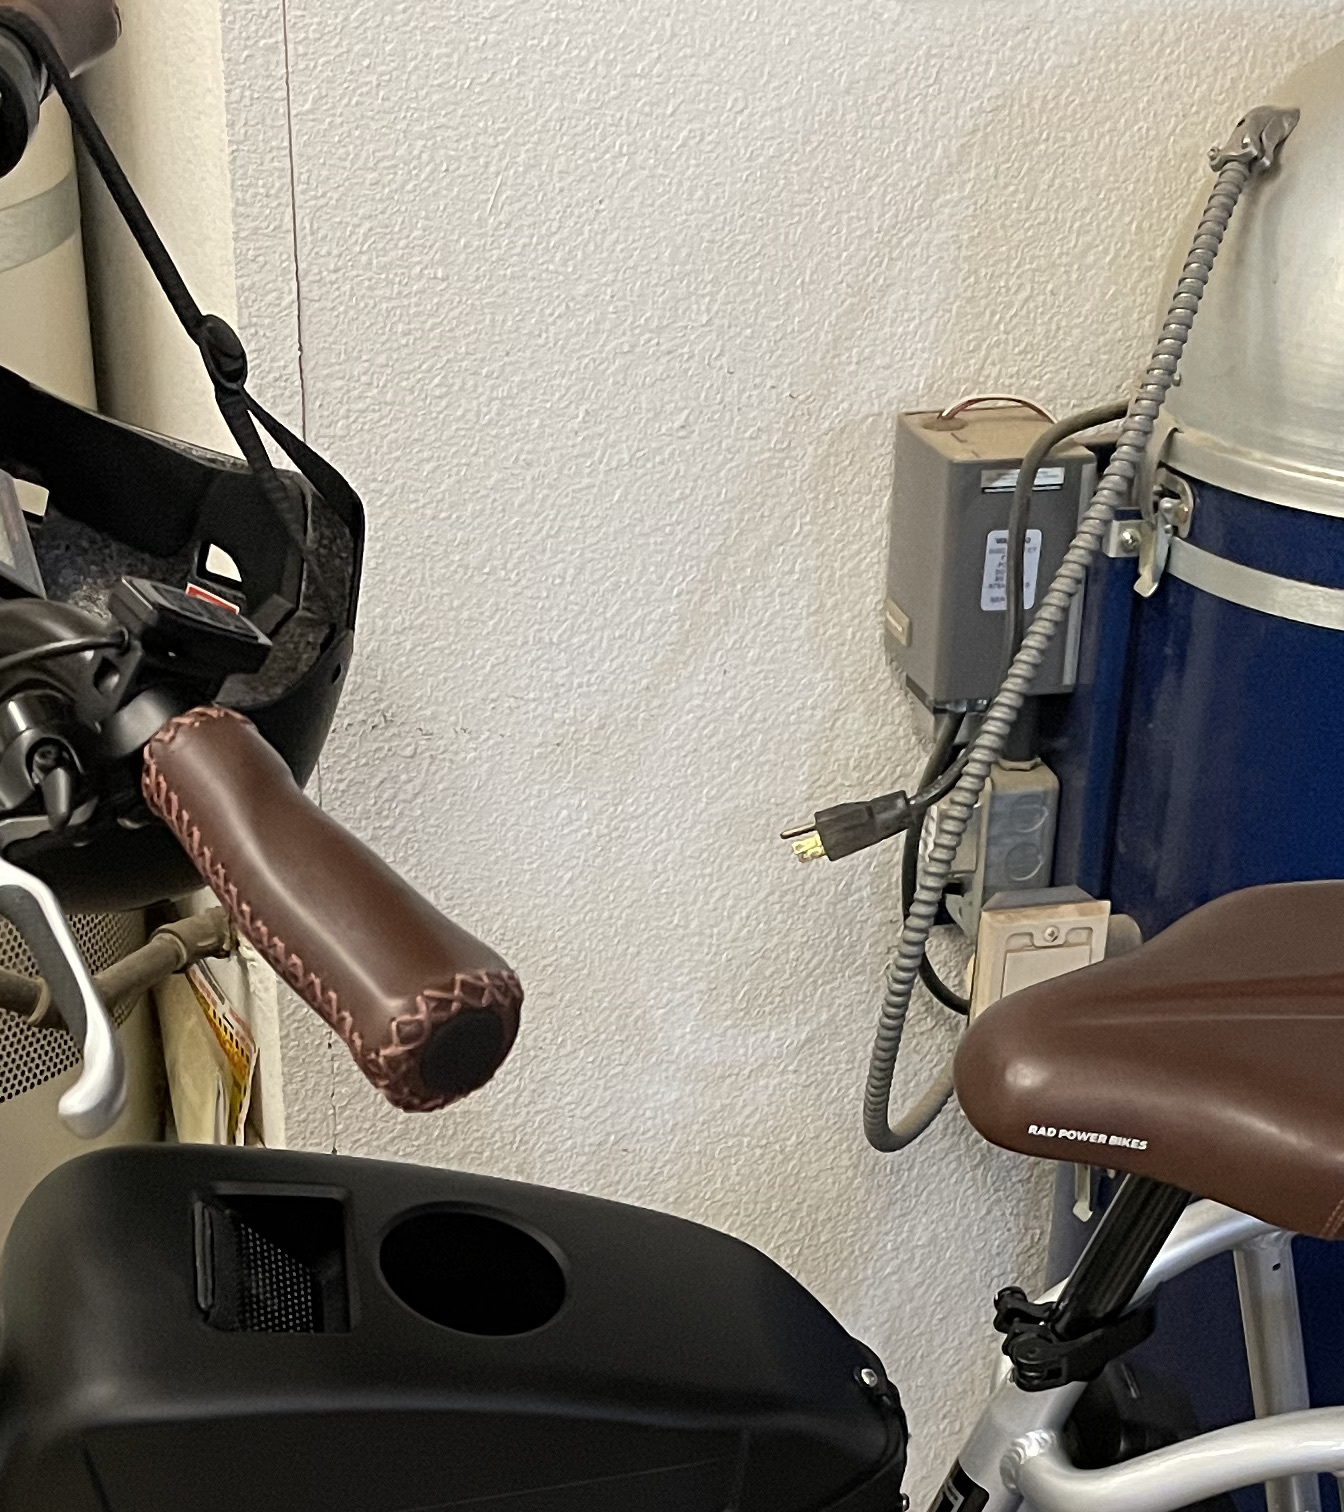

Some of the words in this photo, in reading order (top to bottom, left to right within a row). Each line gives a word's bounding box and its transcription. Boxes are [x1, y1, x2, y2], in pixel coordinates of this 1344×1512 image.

[1028, 1124, 1057, 1138] RAD
[1058, 1129, 1108, 1144] POWER
[1108, 1135, 1148, 1150] BIKES
